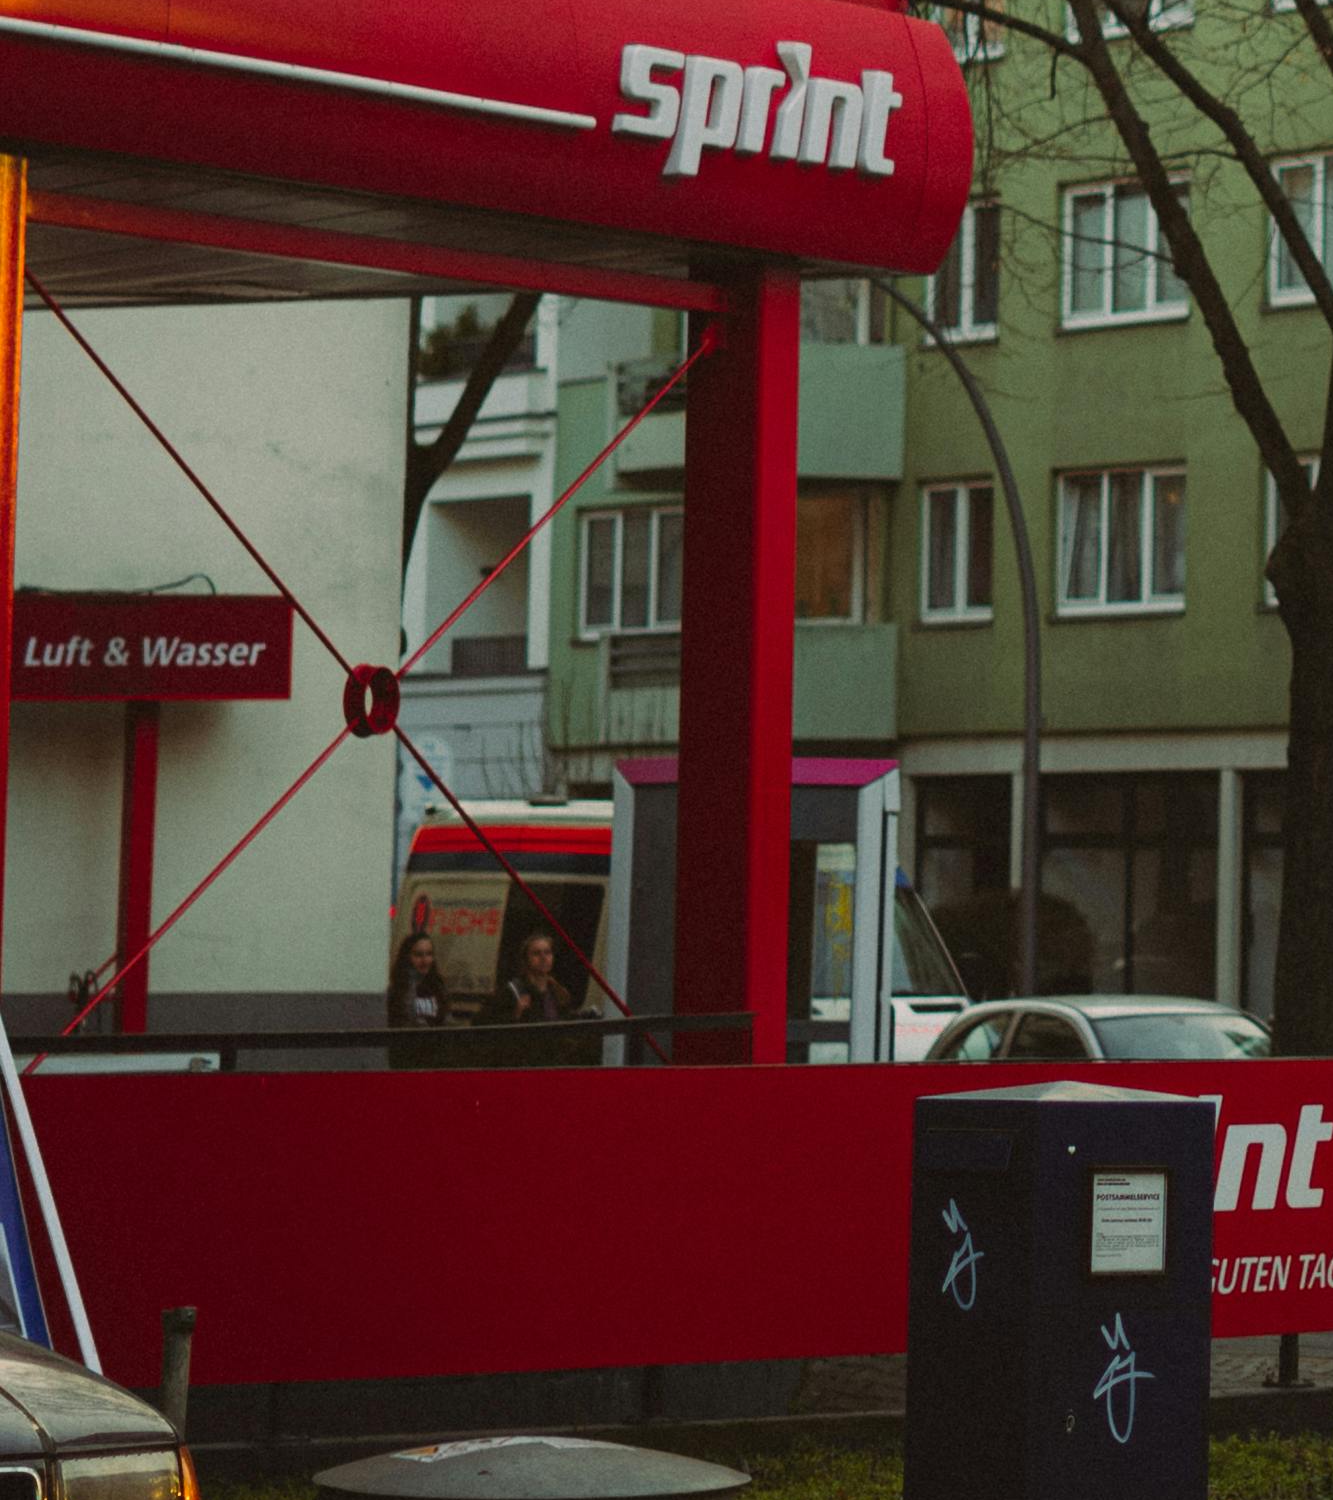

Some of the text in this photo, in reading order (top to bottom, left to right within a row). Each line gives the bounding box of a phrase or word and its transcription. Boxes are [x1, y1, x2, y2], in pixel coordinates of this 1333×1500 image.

[612, 40, 904, 177] sprint
[24, 635, 267, 667] Luft & Wasser
